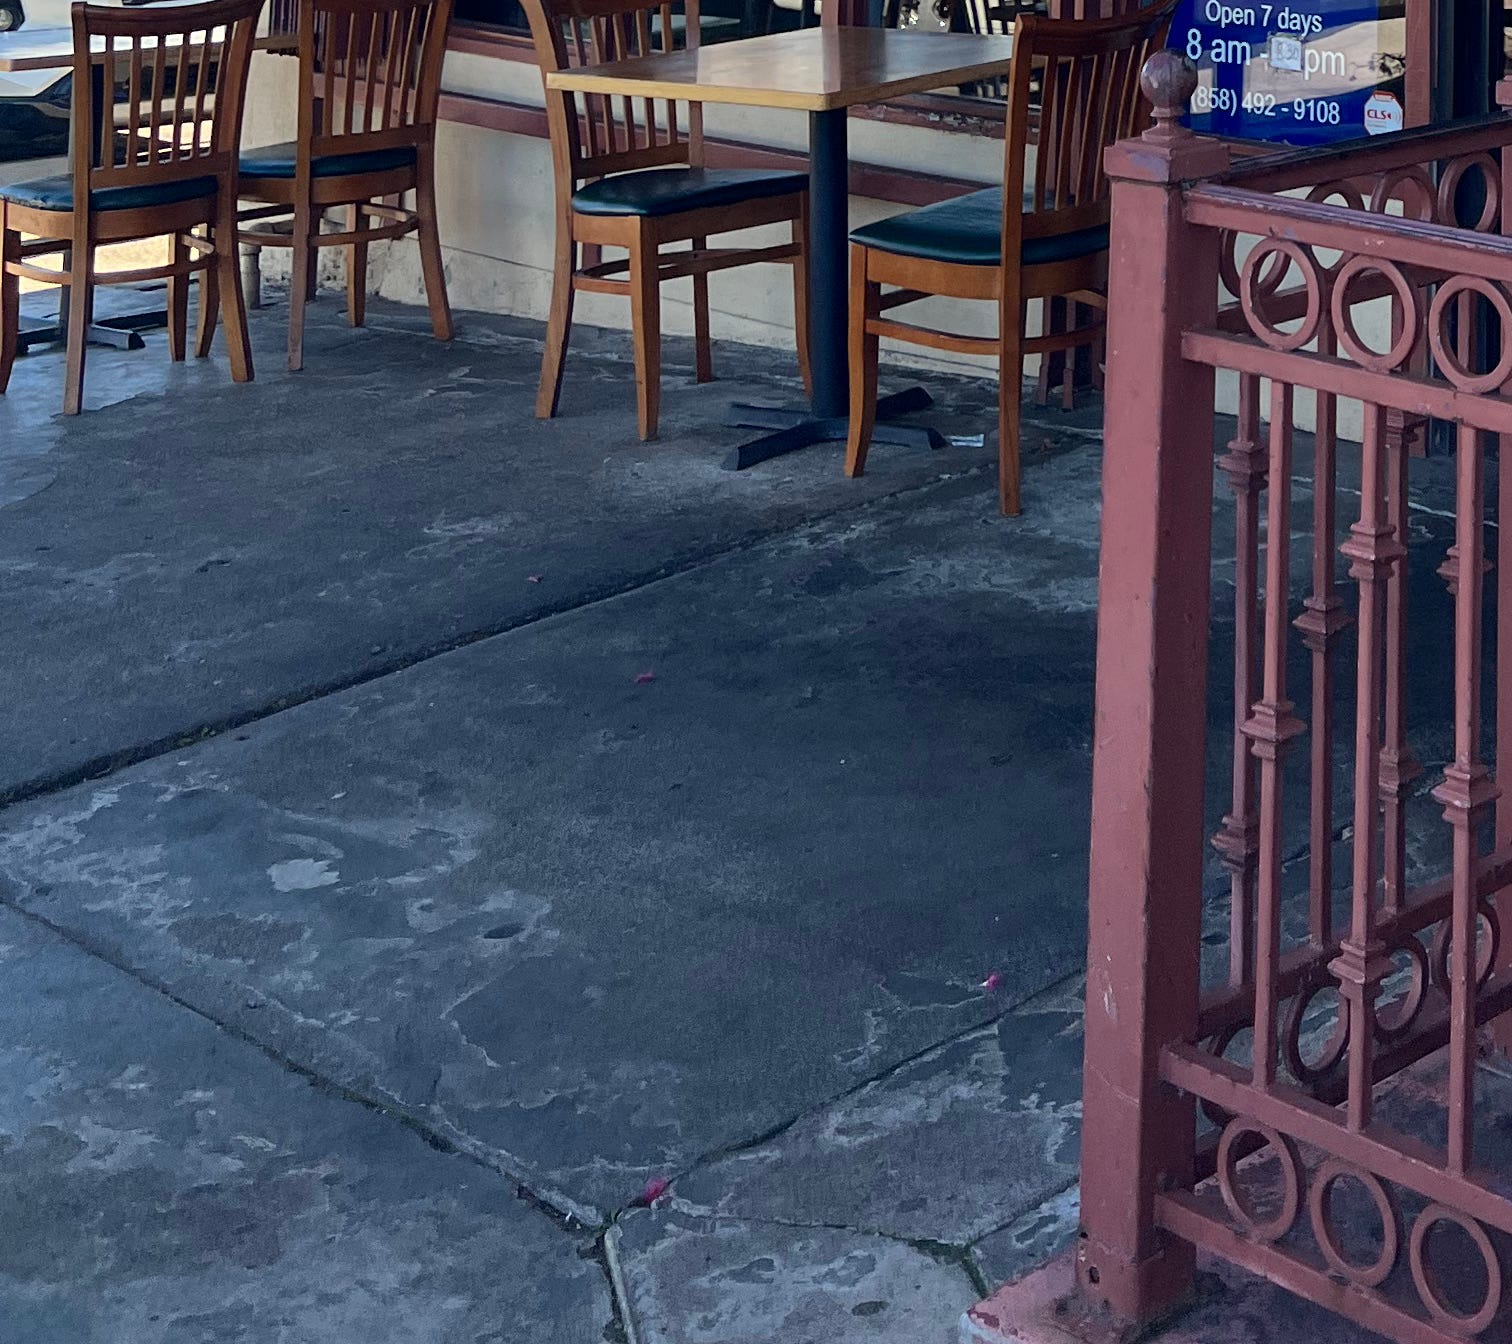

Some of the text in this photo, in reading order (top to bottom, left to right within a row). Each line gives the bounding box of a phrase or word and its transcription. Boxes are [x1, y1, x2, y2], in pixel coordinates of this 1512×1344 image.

[1205, 0, 1322, 39] Open 7 days
[1186, 28, 1202, 60] 8
[1210, 38, 1251, 66] am
[1304, 48, 1345, 80] pm
[1190, 85, 1237, 116] (858)
[1242, 91, 1276, 117] 492
[1293, 98, 1340, 124] 9108
